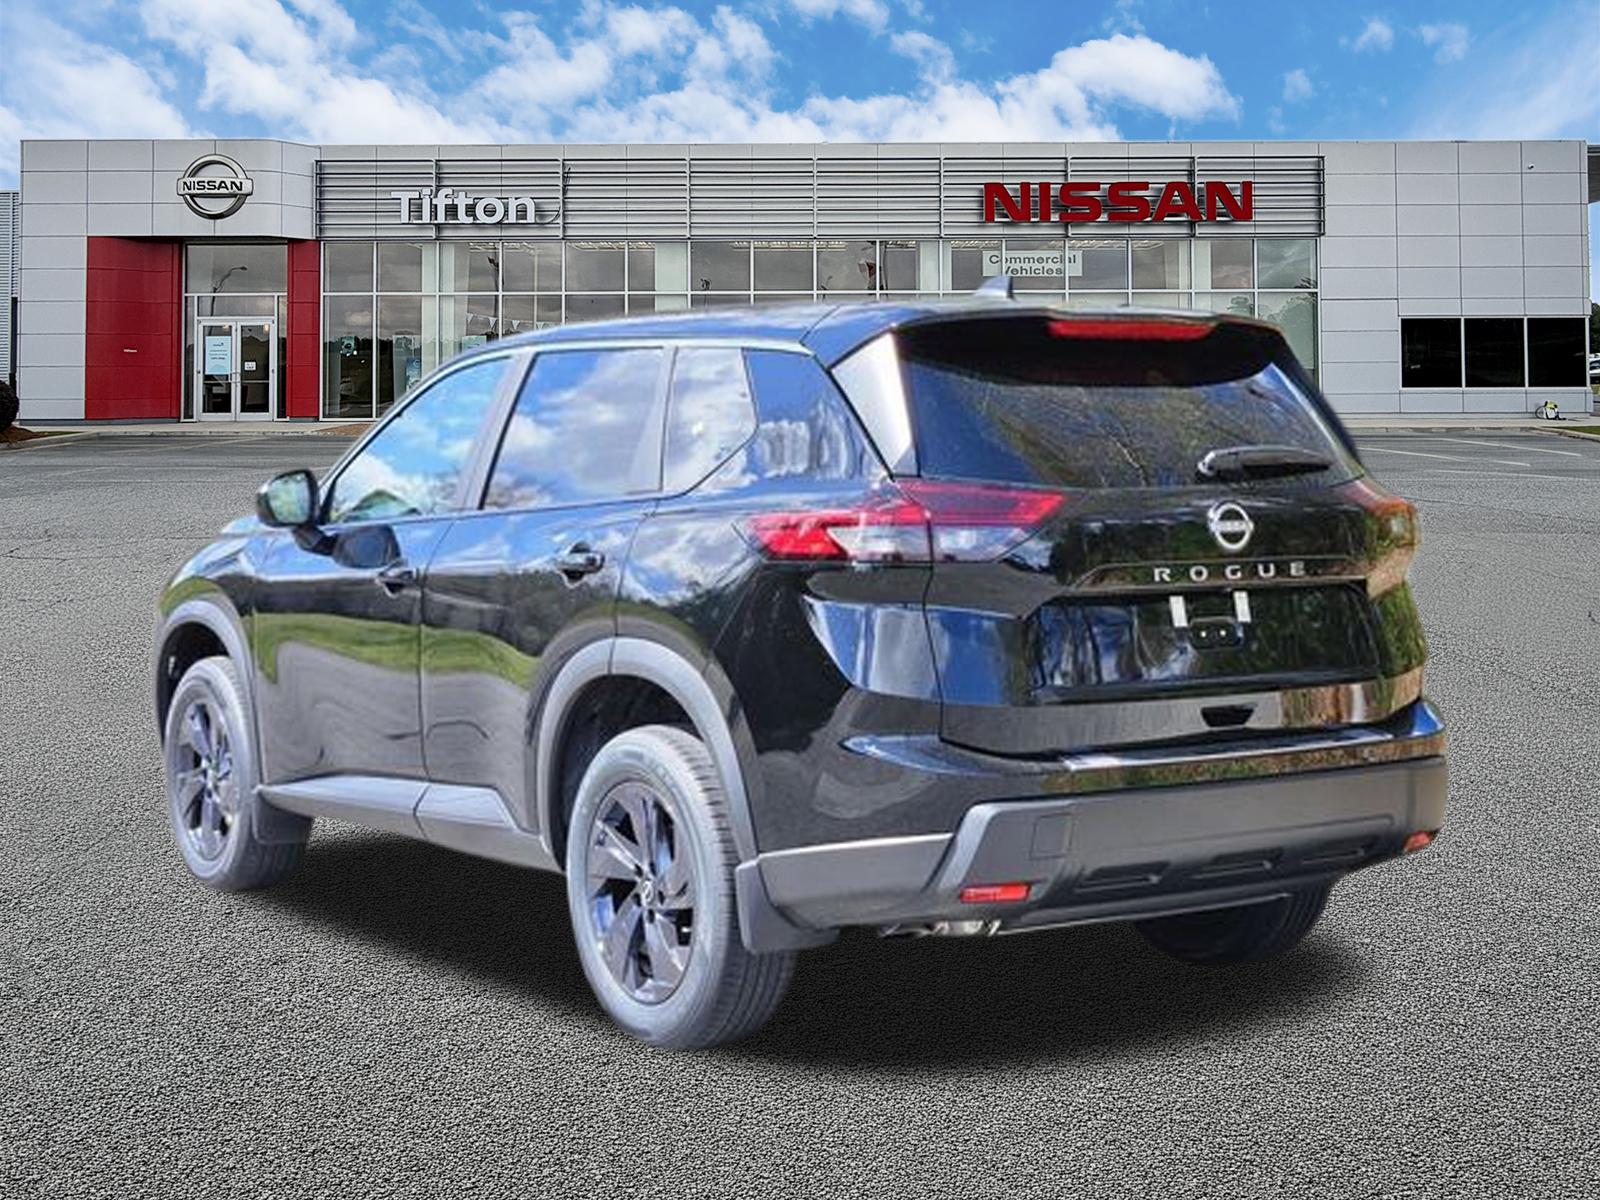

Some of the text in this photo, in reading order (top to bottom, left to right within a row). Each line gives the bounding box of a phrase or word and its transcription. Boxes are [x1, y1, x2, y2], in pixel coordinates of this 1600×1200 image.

[183, 180, 243, 191] NISSAN
[391, 187, 536, 224] Tifton
[984, 181, 1253, 222] NISSAN
[1153, 561, 1305, 582] ROGUE
